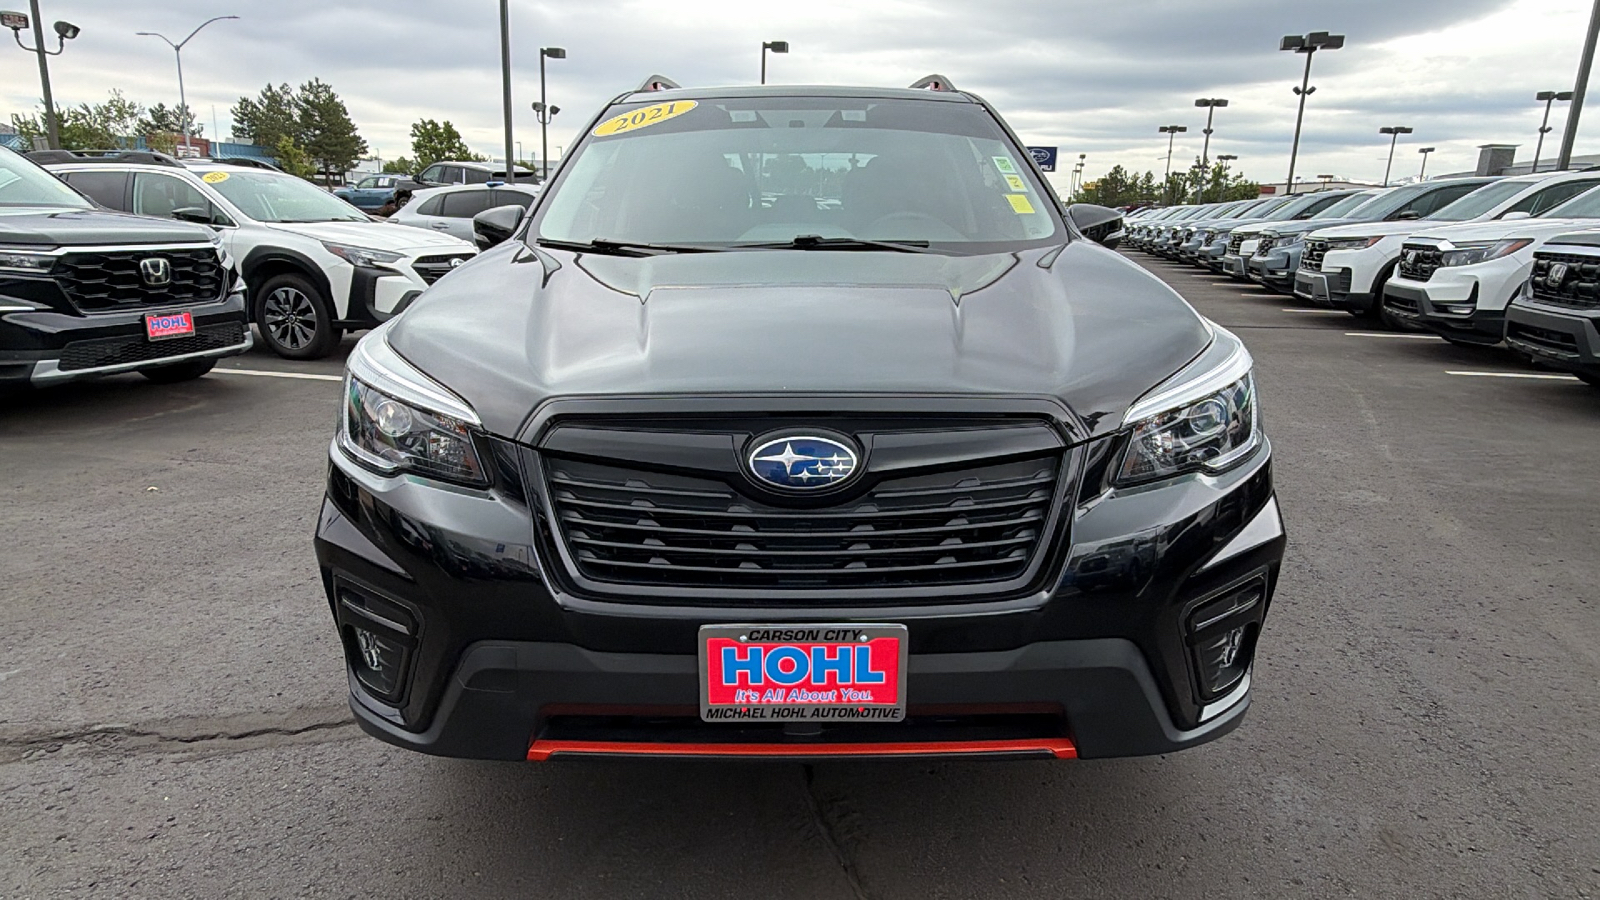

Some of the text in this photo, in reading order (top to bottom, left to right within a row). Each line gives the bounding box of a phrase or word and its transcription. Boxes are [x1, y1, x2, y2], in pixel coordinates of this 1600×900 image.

[614, 103, 676, 132] 2021
[150, 316, 188, 330] HOHL
[749, 630, 863, 641] CARSON CITY
[721, 646, 886, 685] HOHL
[735, 688, 873, 702] It's All About You.
[706, 708, 900, 719] MICHAEL HOHL AUTOMOTIVE
